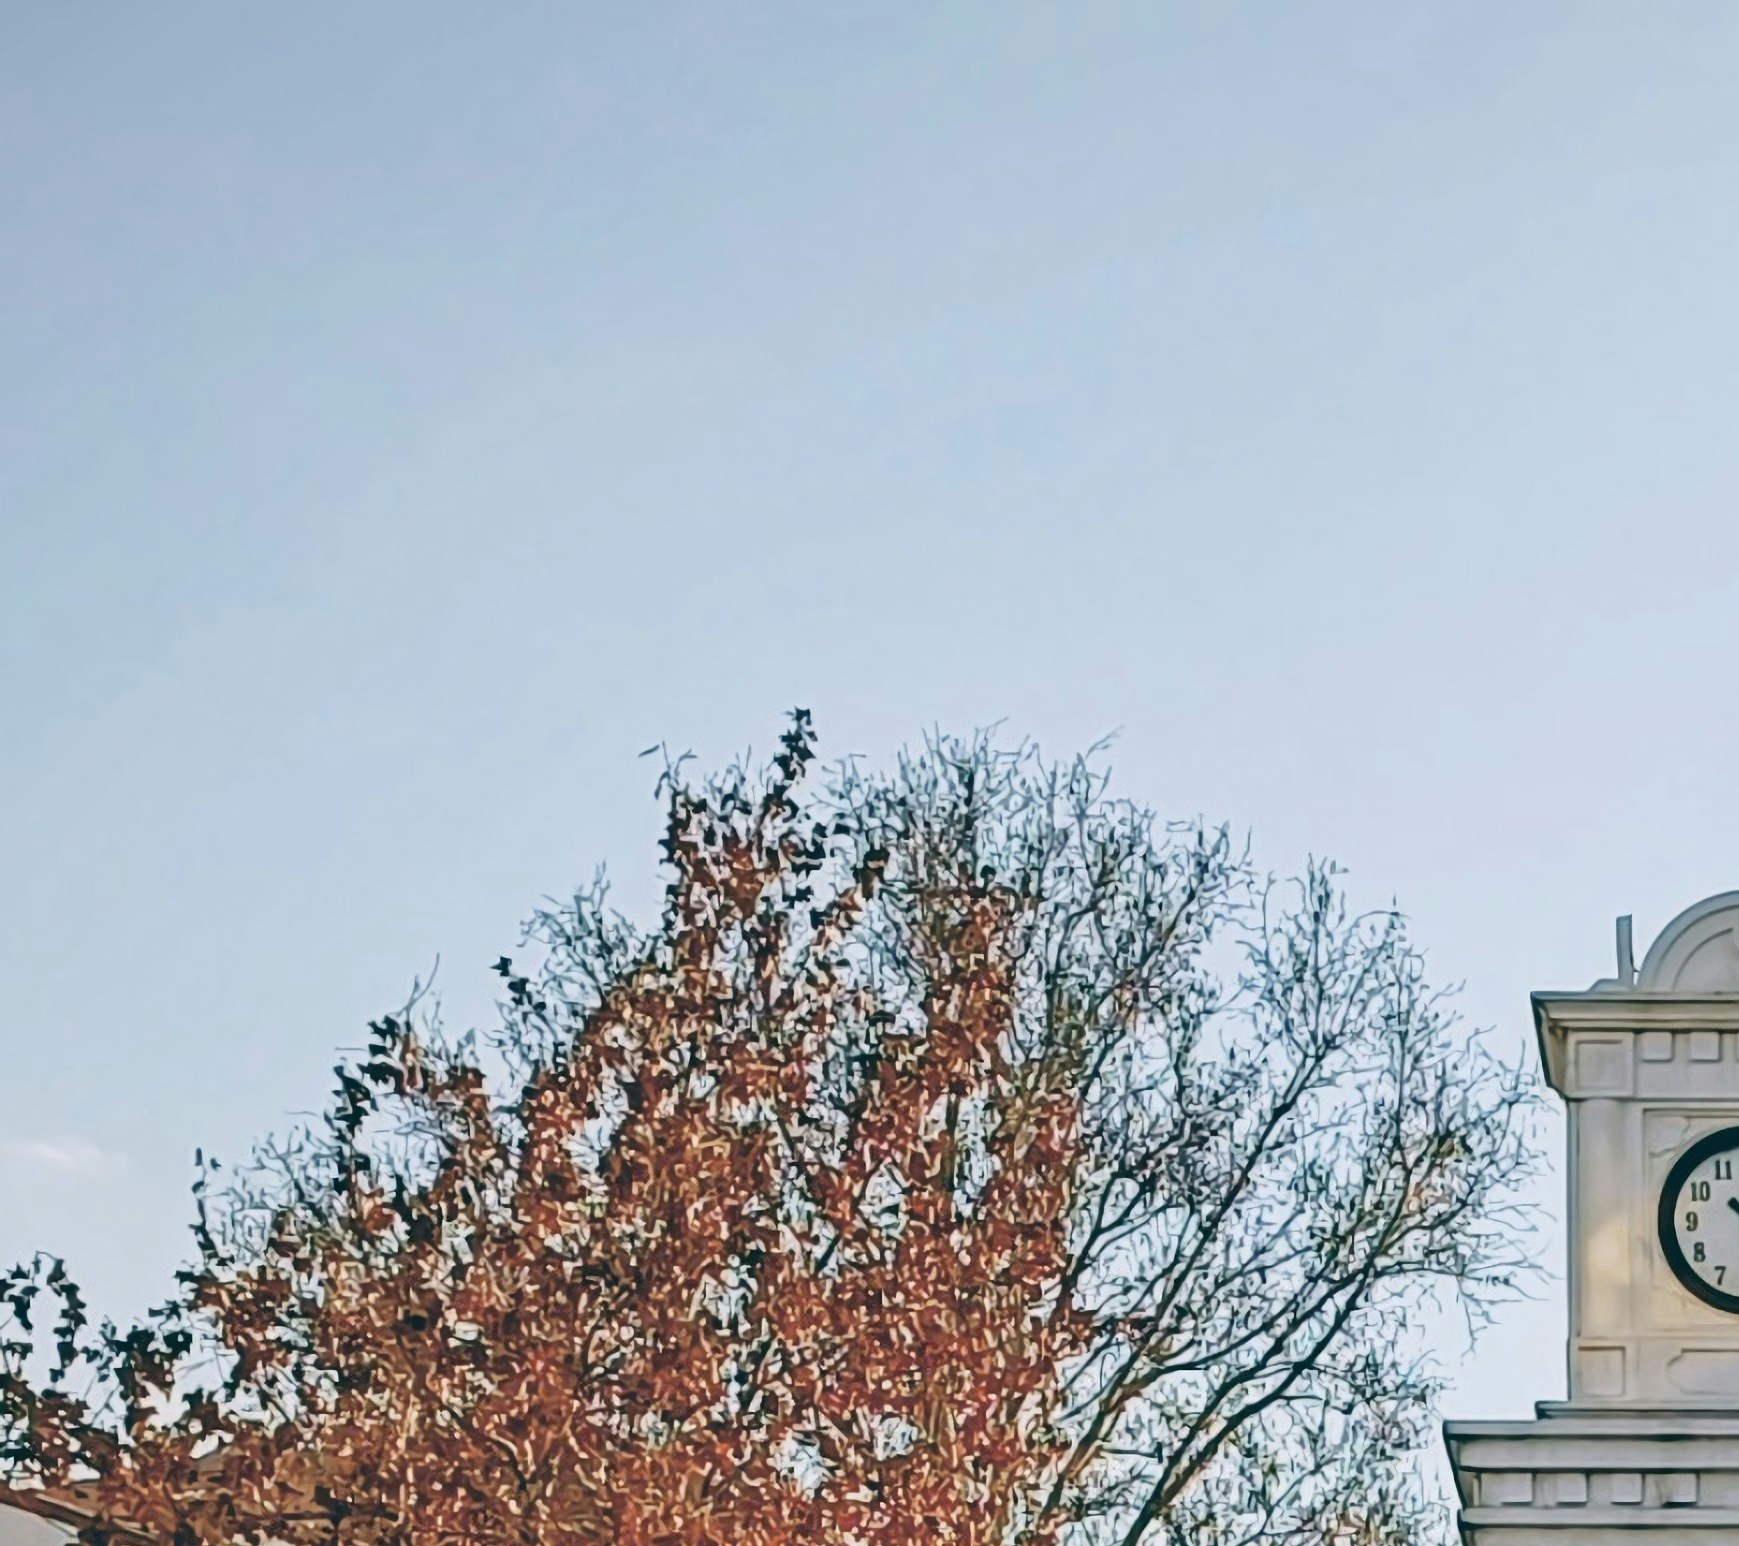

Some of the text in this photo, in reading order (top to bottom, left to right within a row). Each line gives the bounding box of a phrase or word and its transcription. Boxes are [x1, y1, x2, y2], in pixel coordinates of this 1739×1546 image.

[1714, 1160, 1732, 1180] 11
[1691, 1181, 1711, 1202] 10
[1686, 1211, 1698, 1232] 9
[1693, 1241, 1706, 1262] 8
[1714, 1266, 1727, 1286] 7
